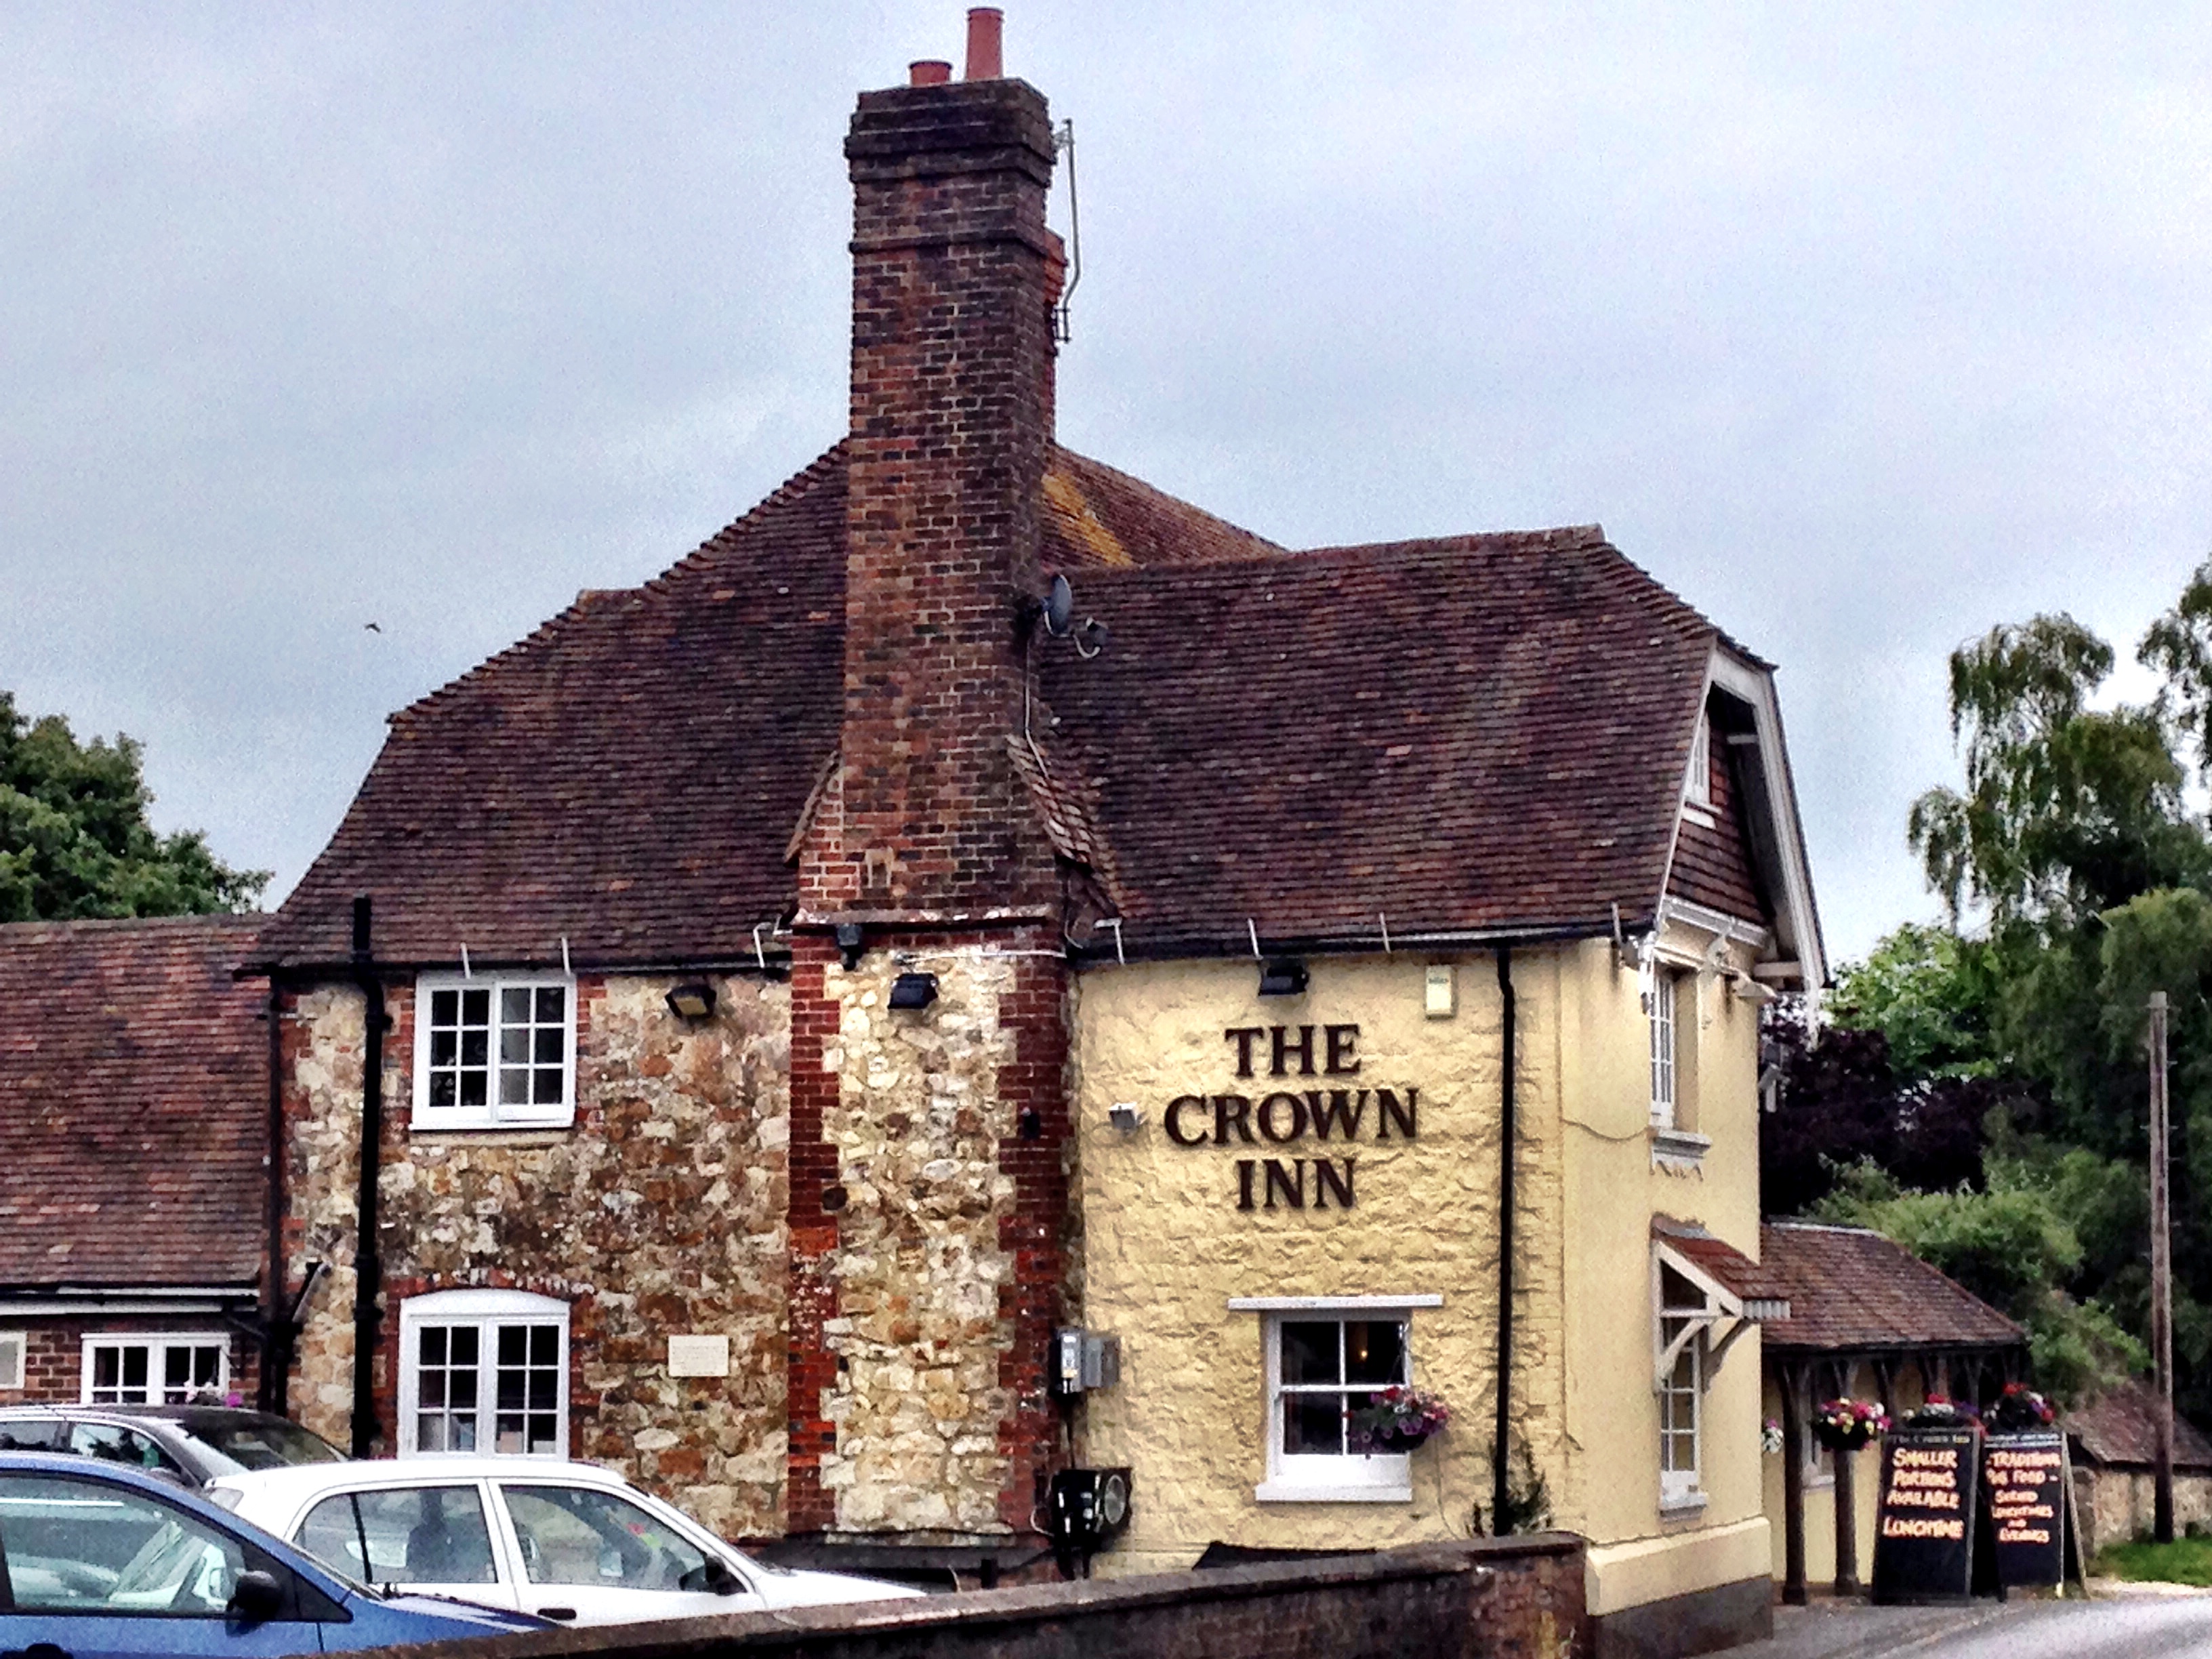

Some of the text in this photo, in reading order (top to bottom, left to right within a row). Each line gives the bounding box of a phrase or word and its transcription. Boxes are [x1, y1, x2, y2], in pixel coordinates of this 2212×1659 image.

[1225, 1023, 1361, 1078] THE
[1164, 1087, 1420, 1147] CROWN
[1235, 1158, 1356, 1210] INN
[1892, 1447, 1959, 1469] SMALLER
[2013, 1469, 2046, 1486] FOOD
